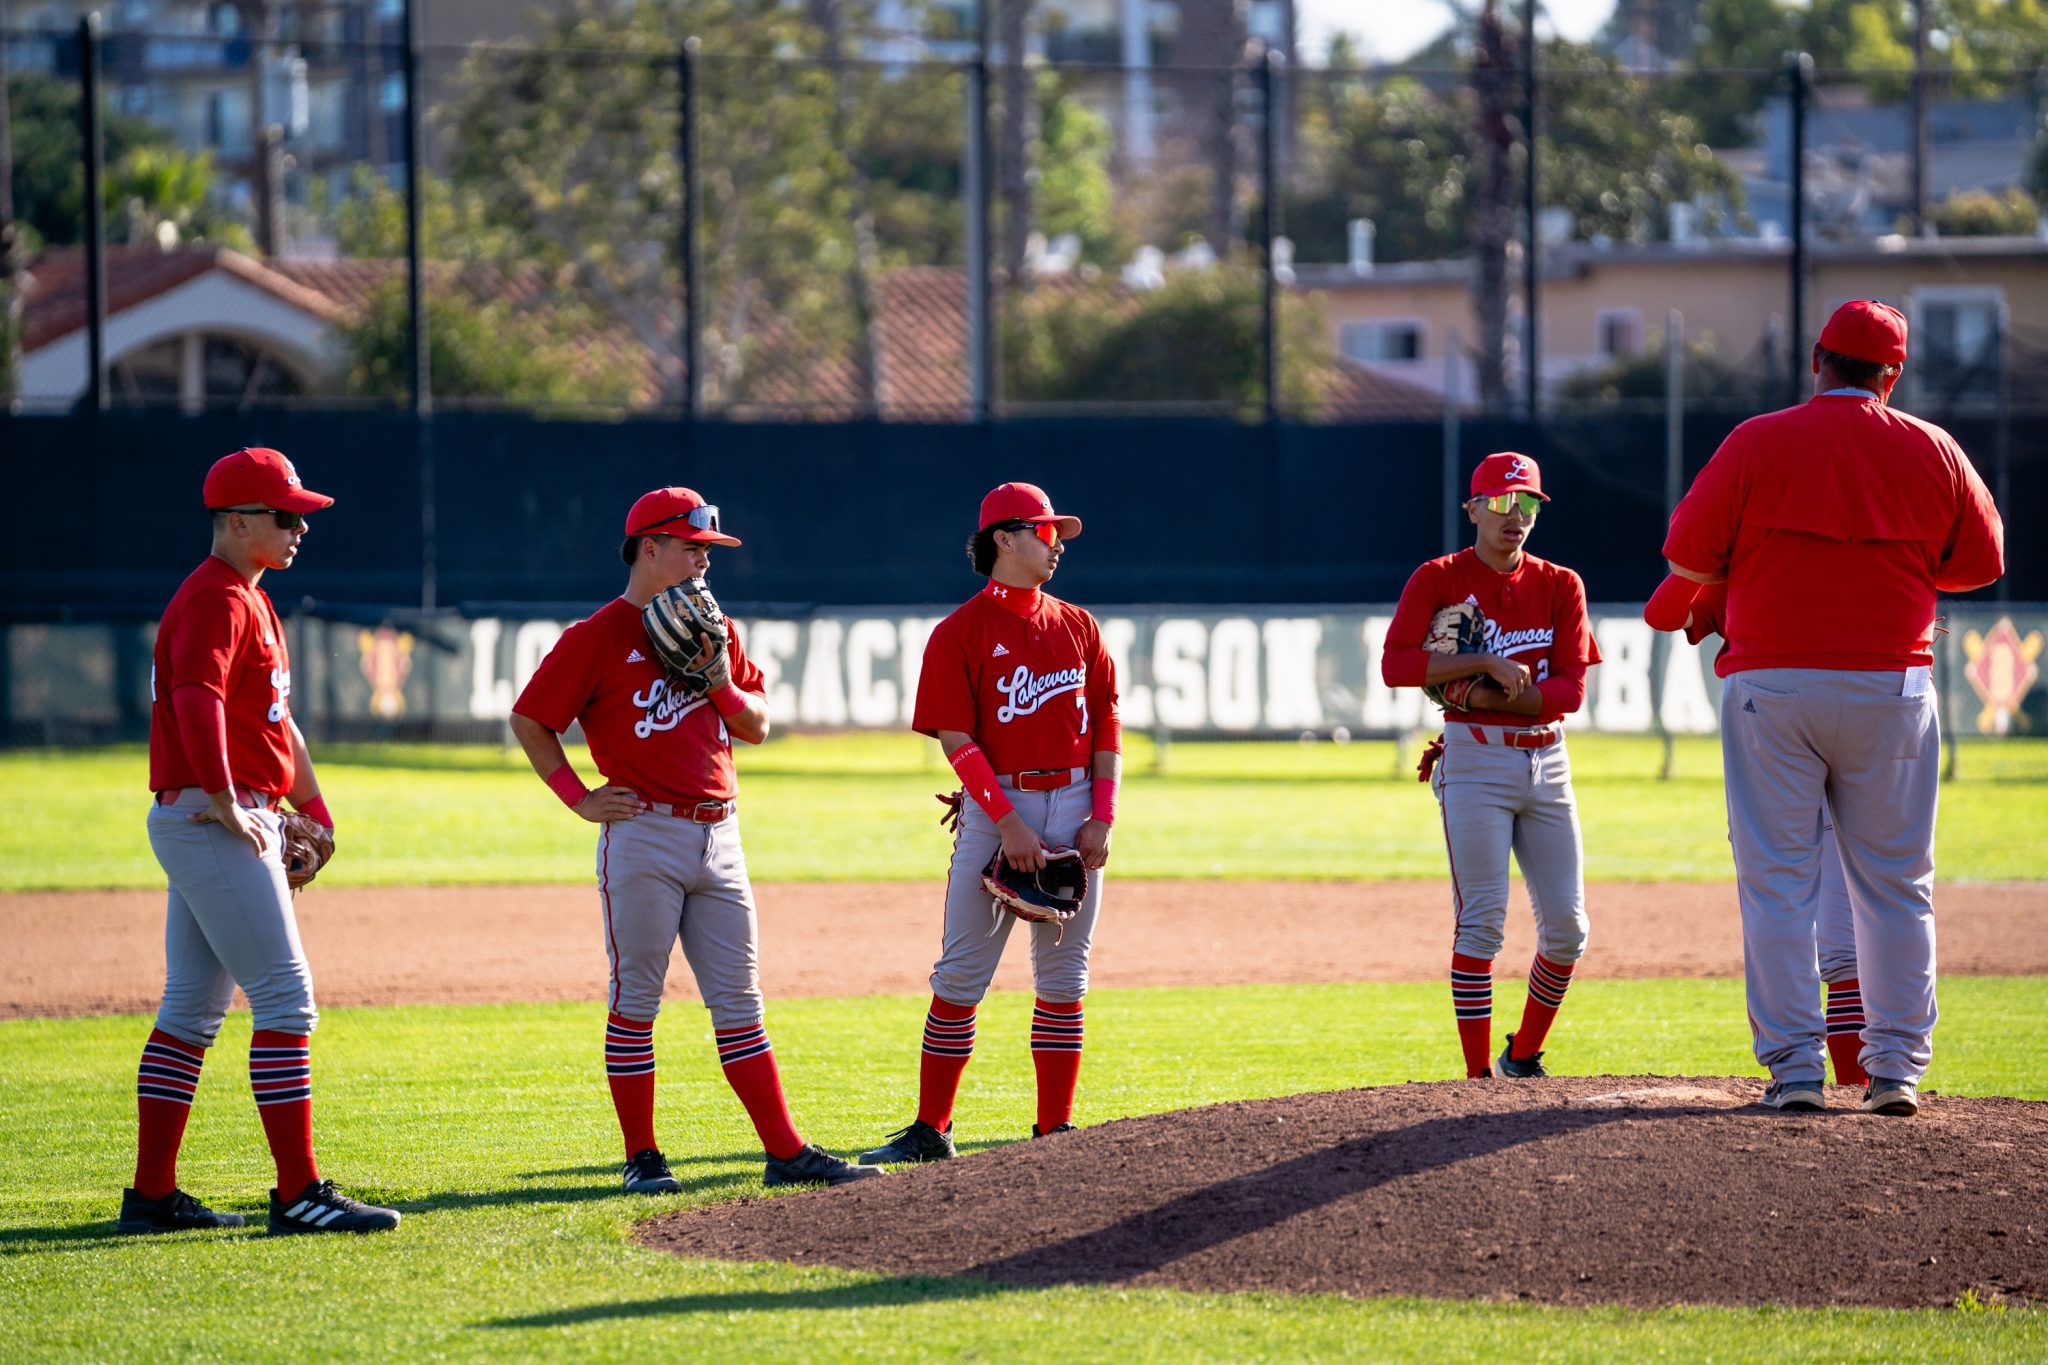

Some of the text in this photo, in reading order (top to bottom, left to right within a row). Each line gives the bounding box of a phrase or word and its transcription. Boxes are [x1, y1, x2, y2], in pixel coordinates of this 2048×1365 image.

[1505, 460, 1530, 479] L
[1103, 618, 1324, 729] LSON
[1076, 696, 1089, 735] 7
